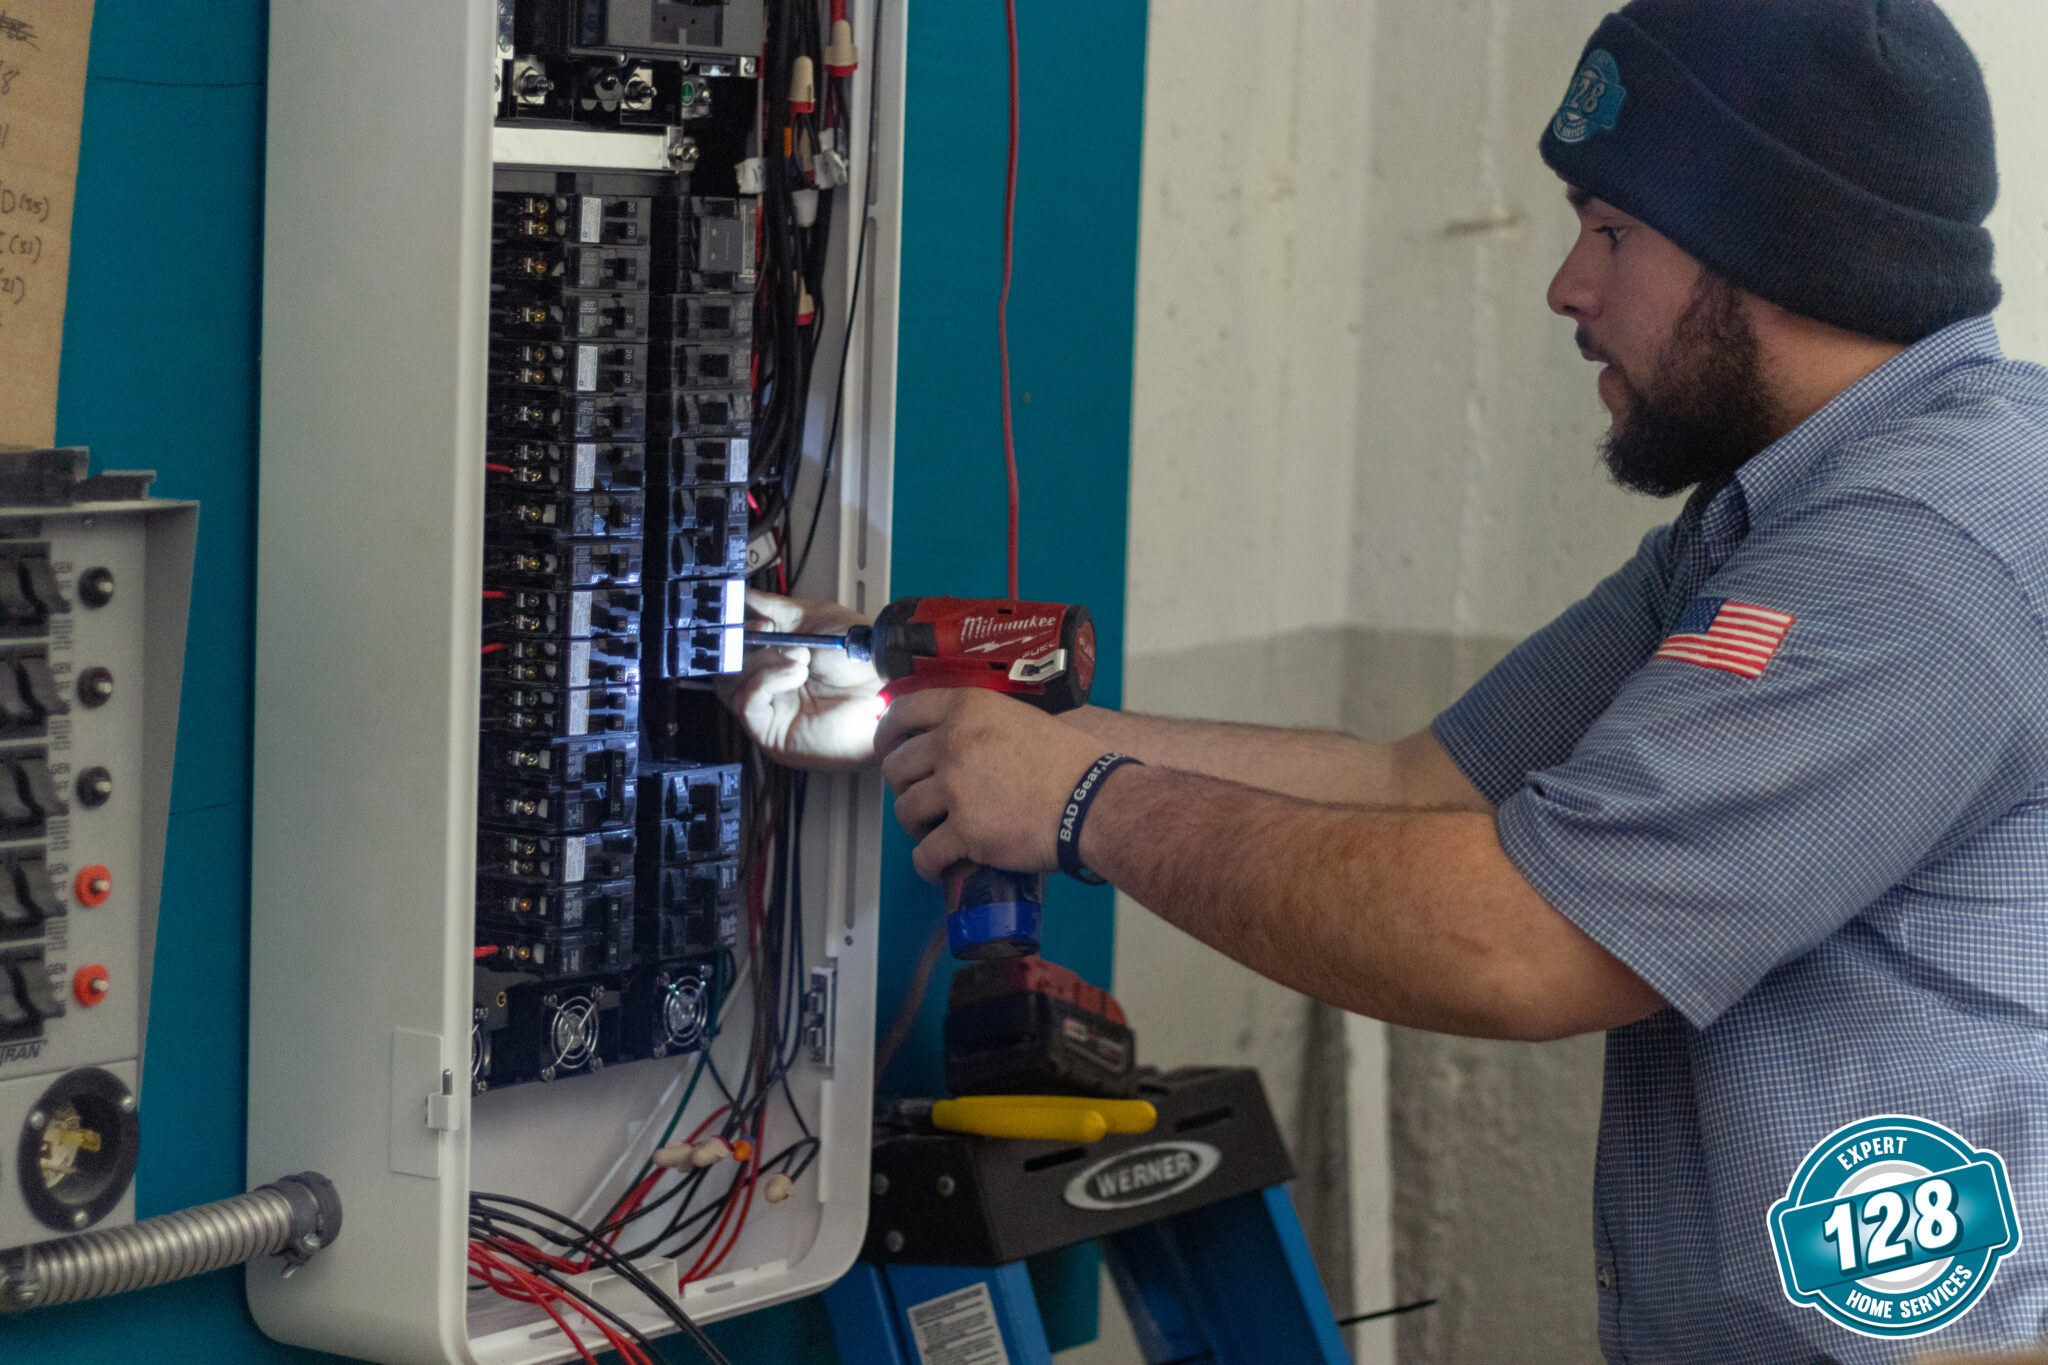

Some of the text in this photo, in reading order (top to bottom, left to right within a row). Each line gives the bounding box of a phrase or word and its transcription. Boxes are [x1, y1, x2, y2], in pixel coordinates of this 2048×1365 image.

[627, 201, 636, 213] 20
[627, 224, 636, 236] 20
[961, 615, 1057, 644] Milwaukee
[1060, 803, 1079, 842] BAD
[1095, 1151, 1193, 1198] WERNER
